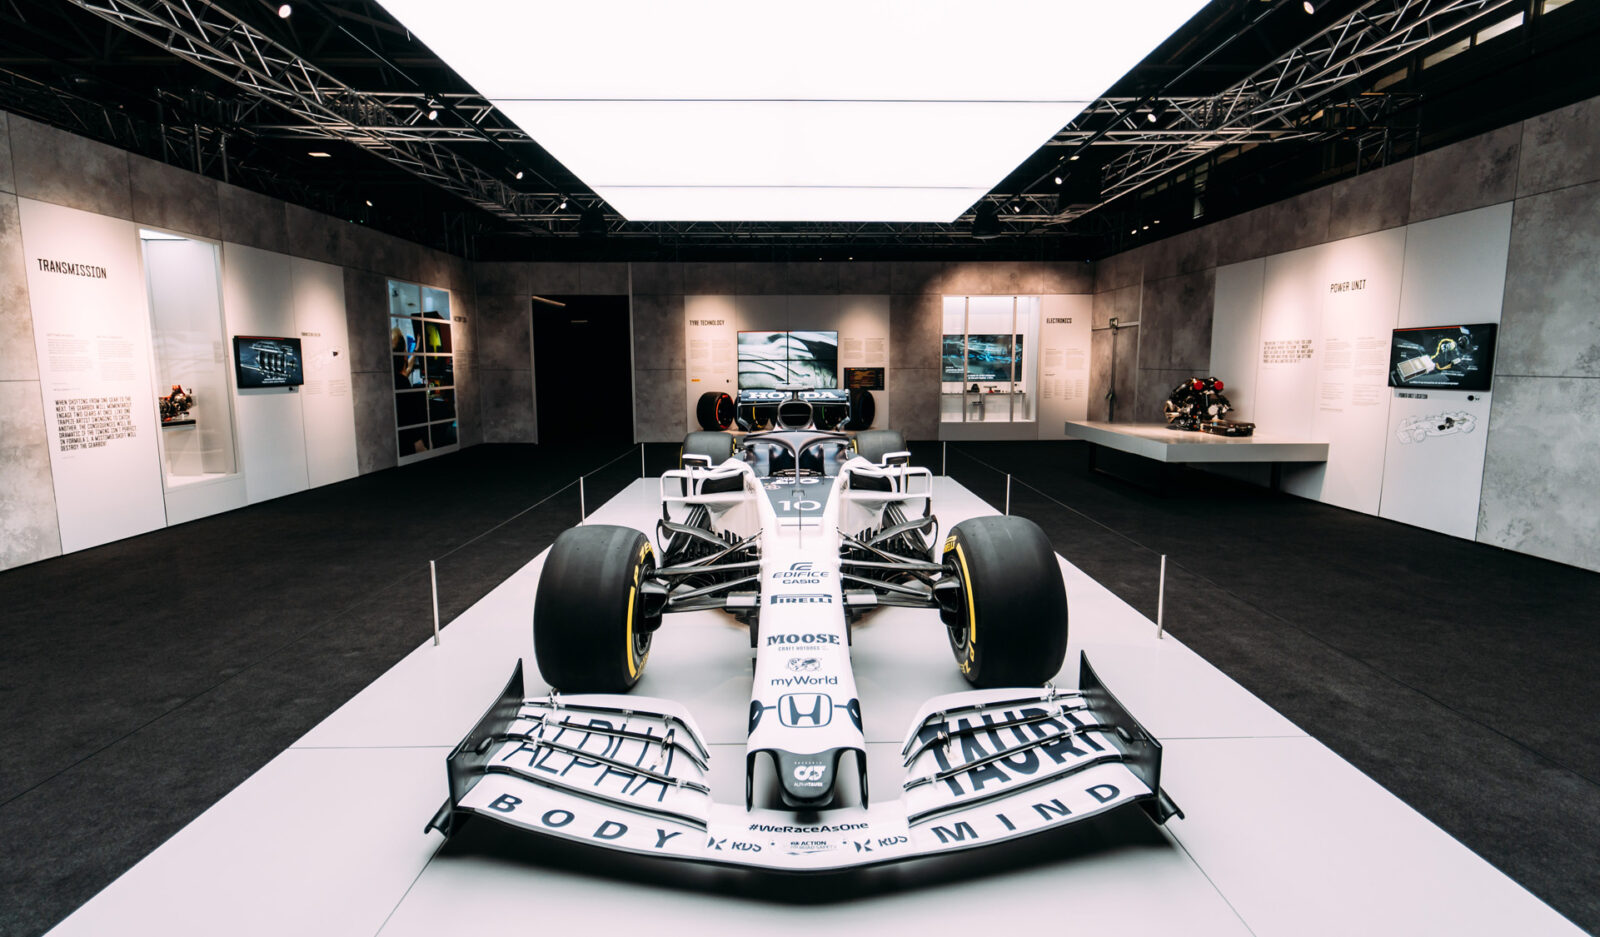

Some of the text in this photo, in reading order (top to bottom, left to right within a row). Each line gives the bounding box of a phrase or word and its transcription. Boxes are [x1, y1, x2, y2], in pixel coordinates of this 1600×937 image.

[37, 258, 107, 279] TRANSMISSION
[1330, 279, 1366, 293] POWER UNIT
[778, 500, 821, 512] 10
[771, 593, 832, 605] PIRELLI
[767, 633, 840, 646] MOOSE
[771, 675, 838, 687] myWorld
[931, 784, 1121, 844] MIND
[488, 794, 682, 848] BODY
[749, 822, 869, 833] #WeRaceAsOne
